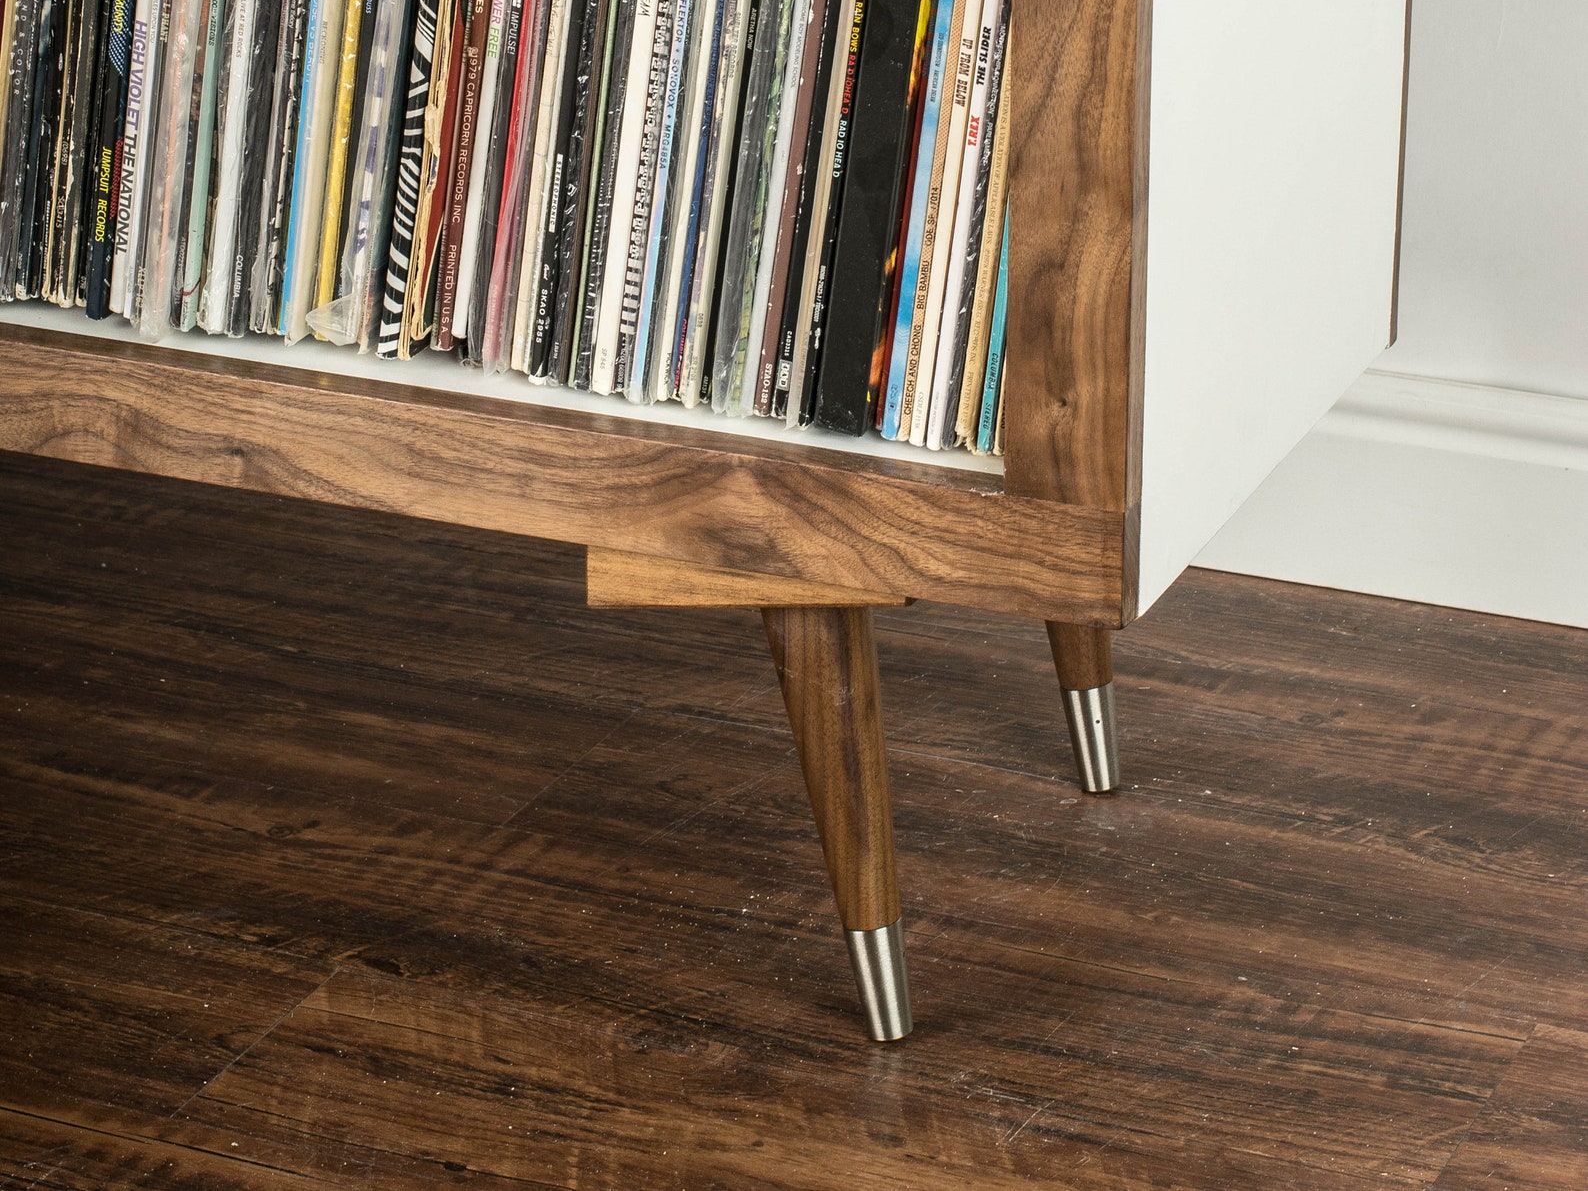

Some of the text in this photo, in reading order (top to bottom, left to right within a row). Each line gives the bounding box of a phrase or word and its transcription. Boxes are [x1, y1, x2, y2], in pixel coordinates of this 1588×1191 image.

[148, 11, 158, 43] UPON YOU
[207, 15, 216, 46] VISIONS
[235, 37, 243, 58] ROCKS
[318, 20, 328, 64] RECKONING
[486, 26, 500, 58] FREE
[505, 10, 520, 55] IMPULSE!
[745, 7, 757, 50] ARETHA NOW
[796, 22, 804, 34] BOY
[848, 26, 859, 52] BOWS
[13, 48, 24, 95] COLOR
[793, 35, 802, 65] MODELING
[975, 26, 992, 85] THE SLIDER
[125, 19, 147, 131] HIGH VIOLET
[665, 58, 680, 109] SONOVOX
[790, 65, 799, 88] SCHOOL
[953, 38, 973, 107] UP FROM BELOW
[458, 82, 475, 146] CAPRICORN
[967, 115, 980, 146] T.REX
[658, 124, 672, 169] MRG485A
[993, 131, 1005, 165] VIOLATION
[93, 146, 112, 242] JUMPSUIT RECORDS
[113, 133, 137, 255] THE NATIONAL
[548, 160, 562, 226] STEREOPHONIC
[991, 169, 1000, 180] OF
[450, 204, 462, 225] INC.
[986, 181, 998, 223] APPLICABLE
[630, 217, 646, 258] World
[983, 224, 993, 244] LAWS
[231, 254, 244, 298] COLUMBIA
[442, 244, 457, 303] PRINTED IN
[535, 288, 548, 343] SKAO 2955
[902, 259, 929, 415] CHEECH AND CHONG BIG BAMBU
[759, 362, 772, 404] STAO-132
[981, 352, 999, 429] COLUMBIA STEREO
